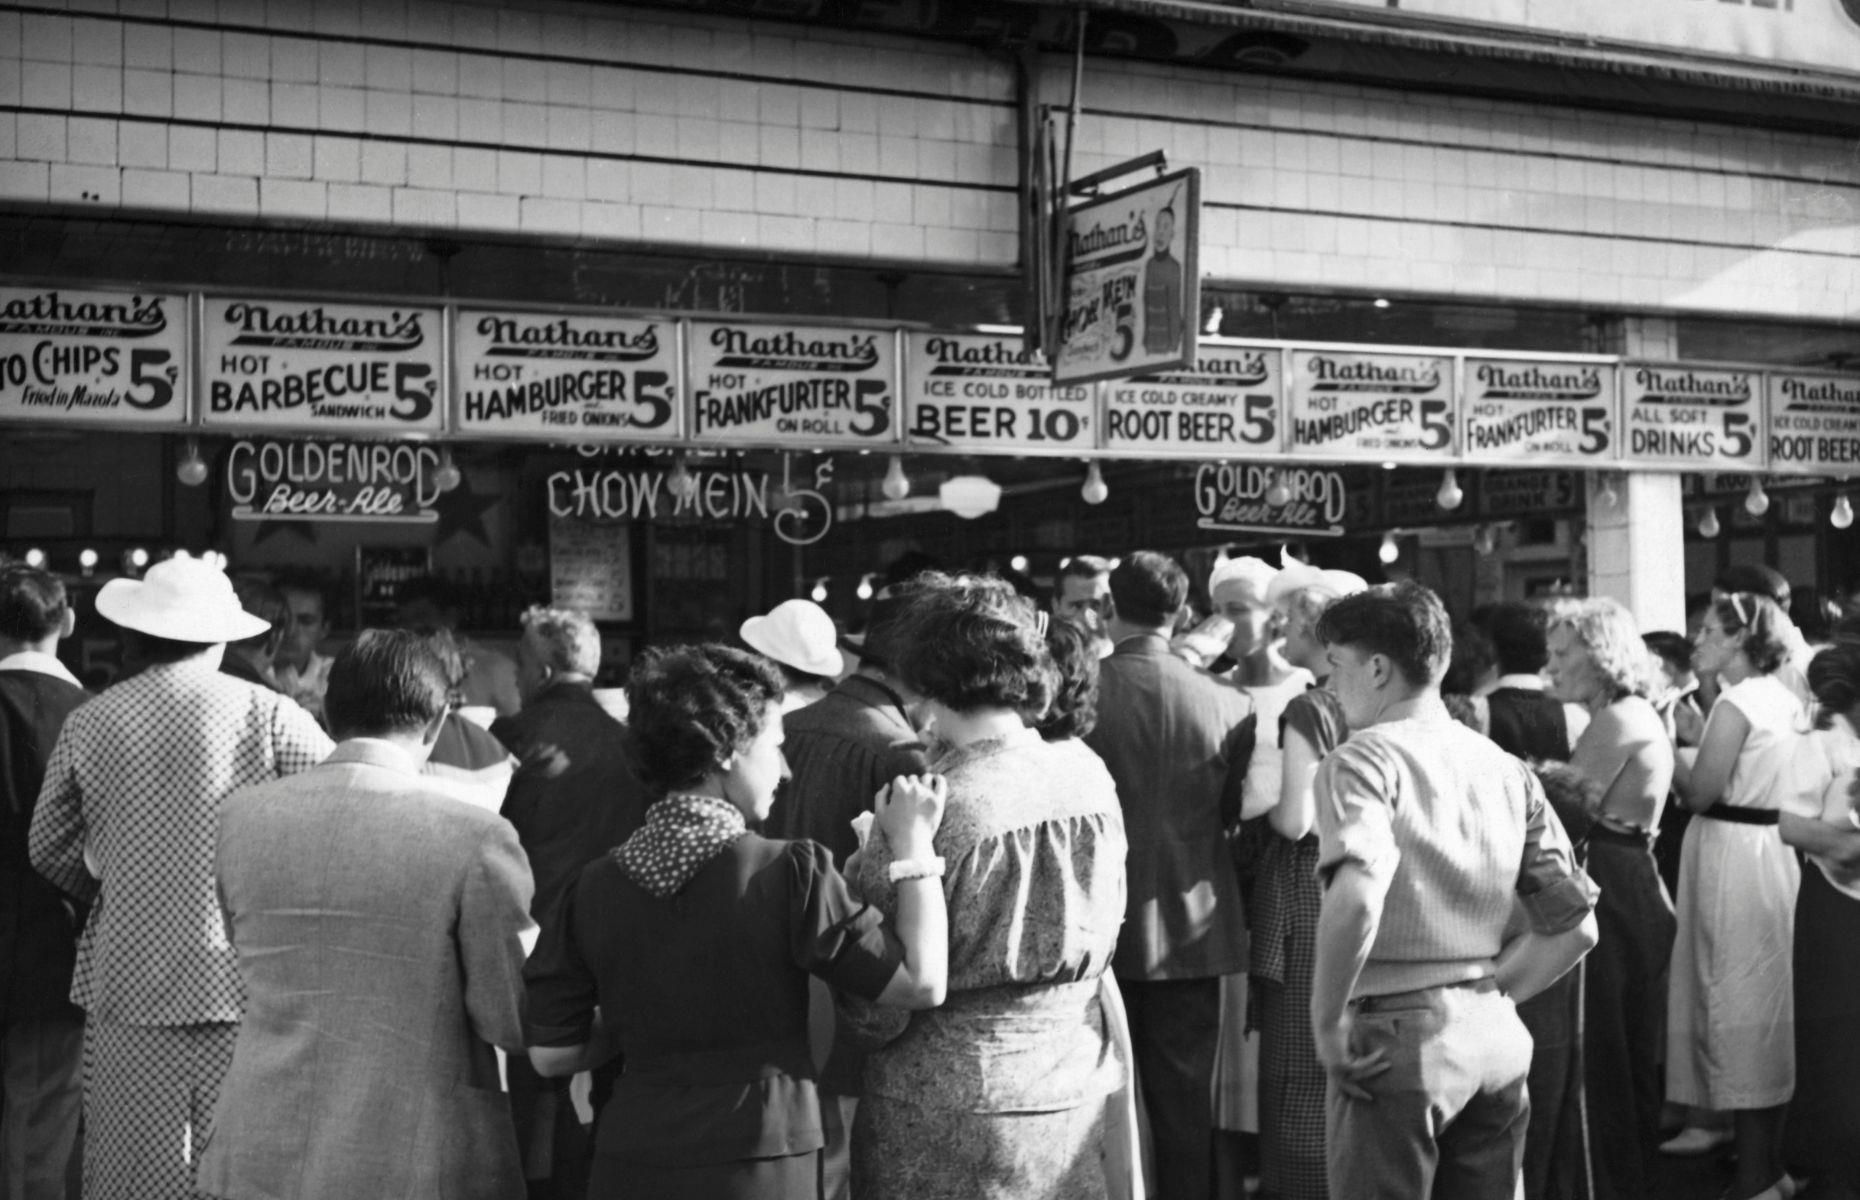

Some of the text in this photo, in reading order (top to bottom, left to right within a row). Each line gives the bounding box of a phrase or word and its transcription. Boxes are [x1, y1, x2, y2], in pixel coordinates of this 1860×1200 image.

[0, 292, 167, 326] athan's
[225, 302, 423, 340] Nathan's
[710, 327, 879, 361] Nathan's
[33, 340, 121, 385] CHIPS
[221, 354, 270, 375] HOT
[474, 363, 524, 381] HOT
[211, 362, 389, 413] BARBECUE
[465, 370, 626, 422] HAMBURGER
[708, 374, 747, 390] HOT
[923, 380, 1088, 402] ICE COLD BOTTLED
[310, 403, 386, 419] SANDWICH
[694, 379, 851, 435] FRANKFURTER
[1115, 390, 1238, 407] ICE COLD CREAMY
[1308, 397, 1338, 411] HOT
[1473, 405, 1503, 417] HOT
[542, 410, 578, 426] FRIED
[776, 418, 845, 435] ON ROLL
[909, 403, 1017, 444] BEER
[1109, 409, 1237, 443] ROOT BEER
[1295, 399, 1413, 445] HAMBURGER
[1467, 406, 1577, 452] FRANKFURTER
[1631, 408, 1707, 423] ALL SOFT
[1793, 416, 1820, 430] COLD
[1823, 418, 1860, 431] CREAM
[1632, 428, 1715, 457] DRINKS
[1771, 435, 1860, 462] ROOT BEER
[228, 441, 441, 508] GOLDENROD
[547, 469, 769, 518] CHOW MEIN
